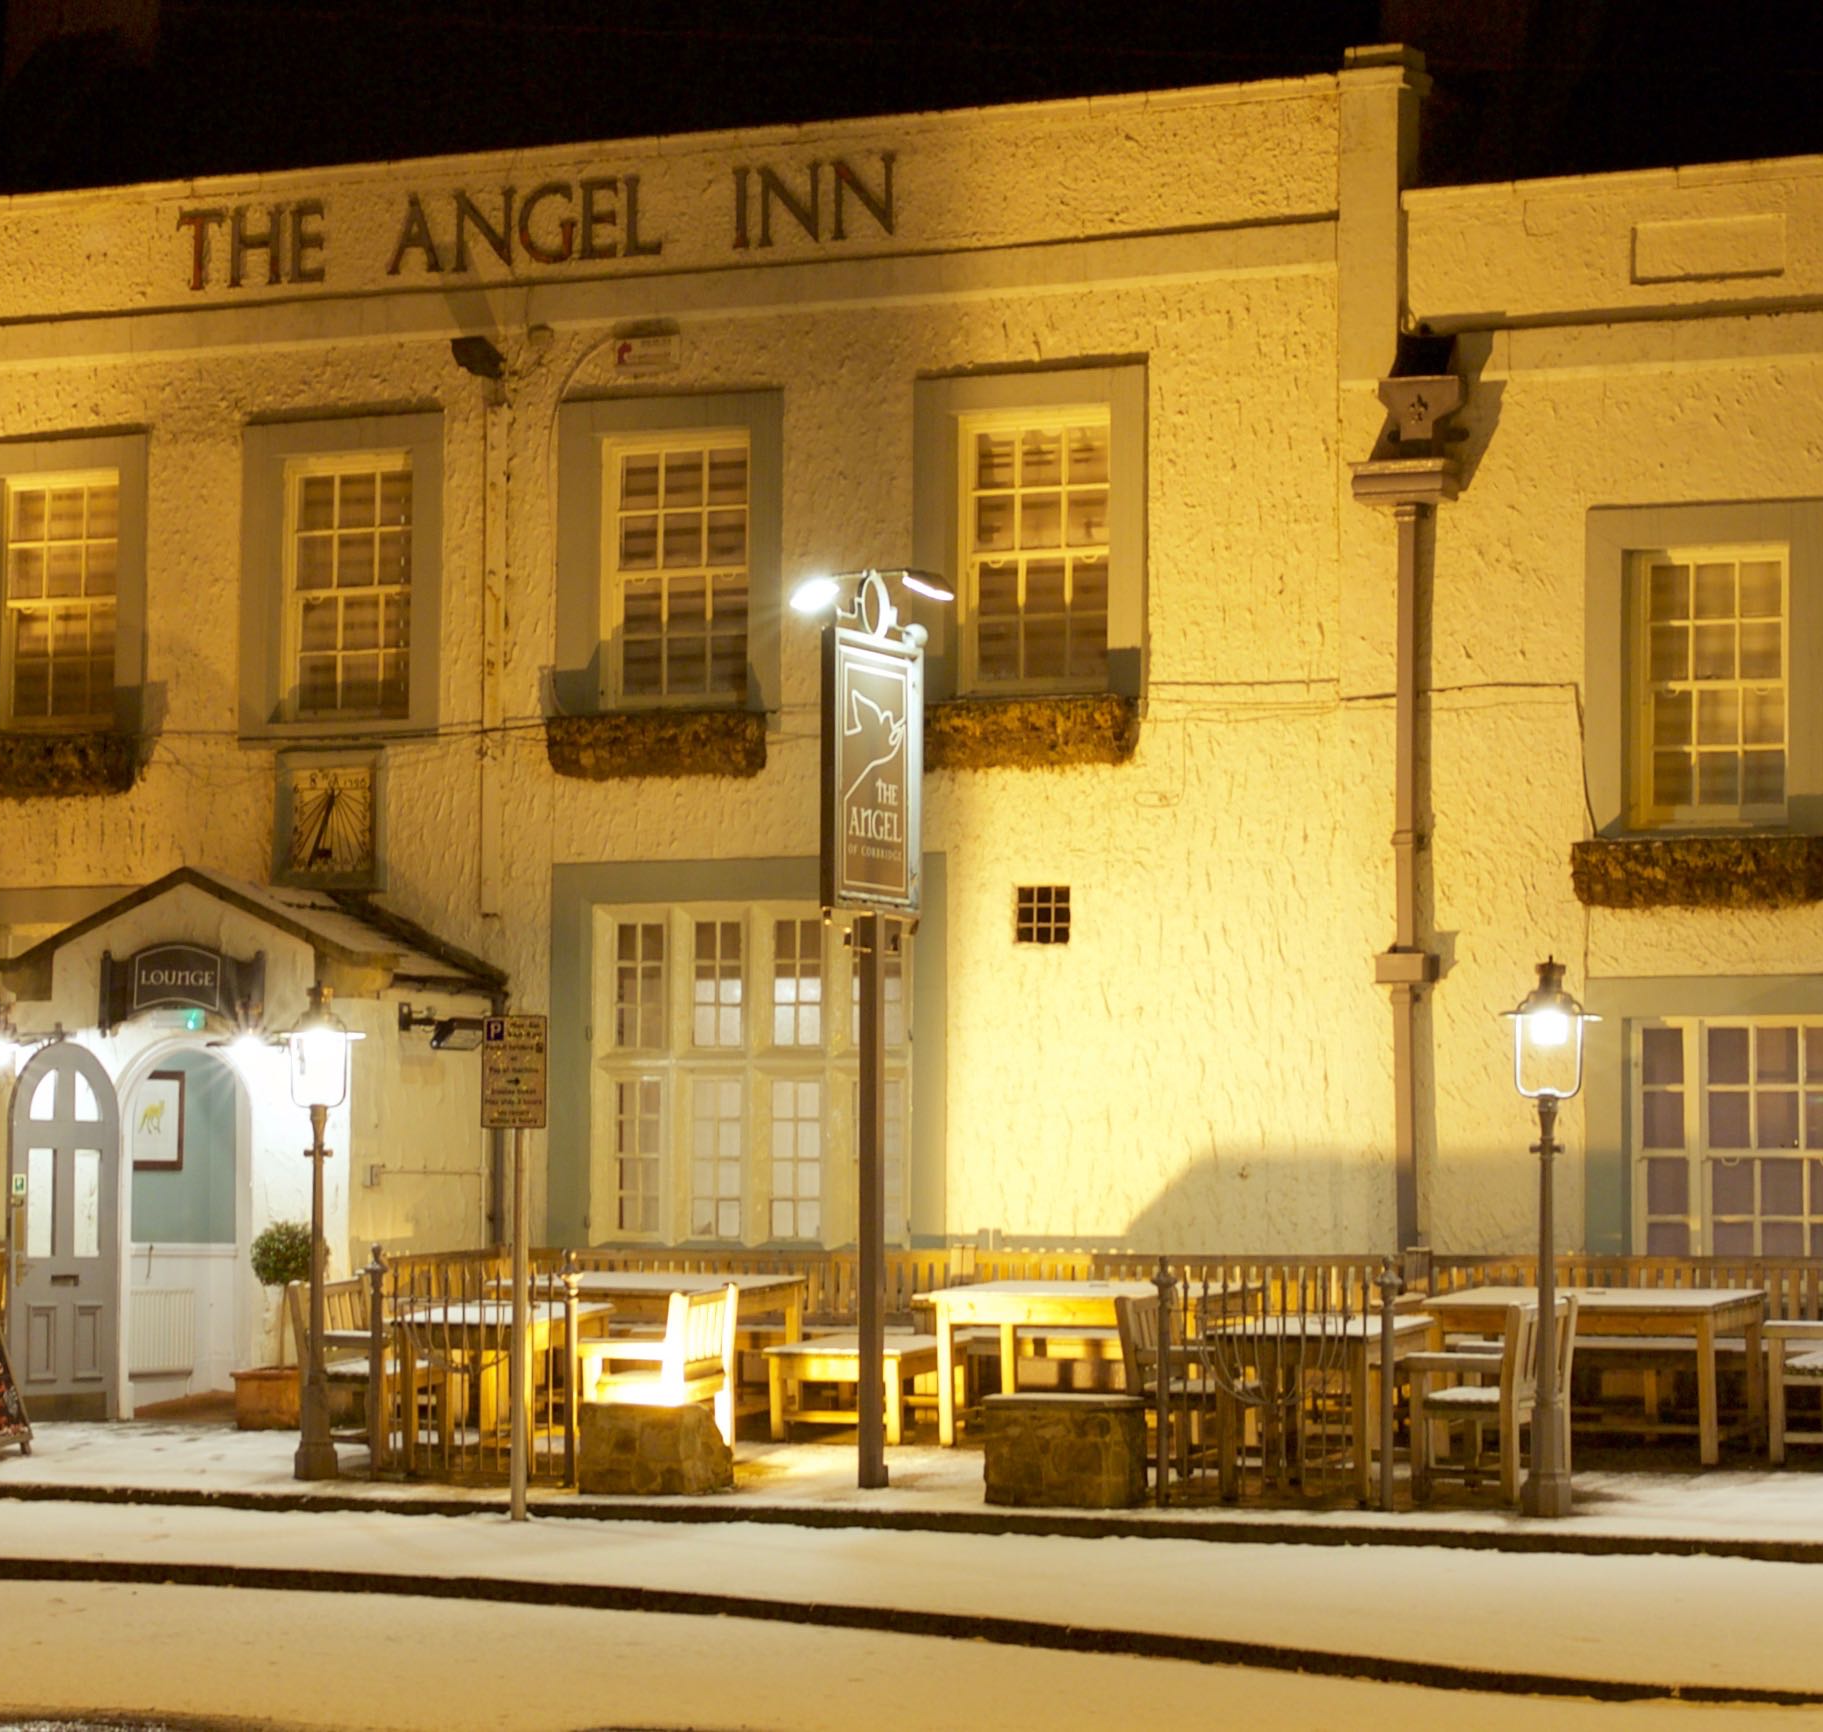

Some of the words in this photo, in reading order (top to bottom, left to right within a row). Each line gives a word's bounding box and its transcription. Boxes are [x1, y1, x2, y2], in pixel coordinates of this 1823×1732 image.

[177, 200, 326, 291] THE
[385, 173, 663, 277] ANGEL
[731, 151, 897, 250] INN
[875, 777, 899, 806] THE
[848, 806, 902, 843] ANGEL
[848, 843, 858, 856] OF
[140, 969, 215, 987] LOUNGE
[490, 1022, 502, 1040] P
